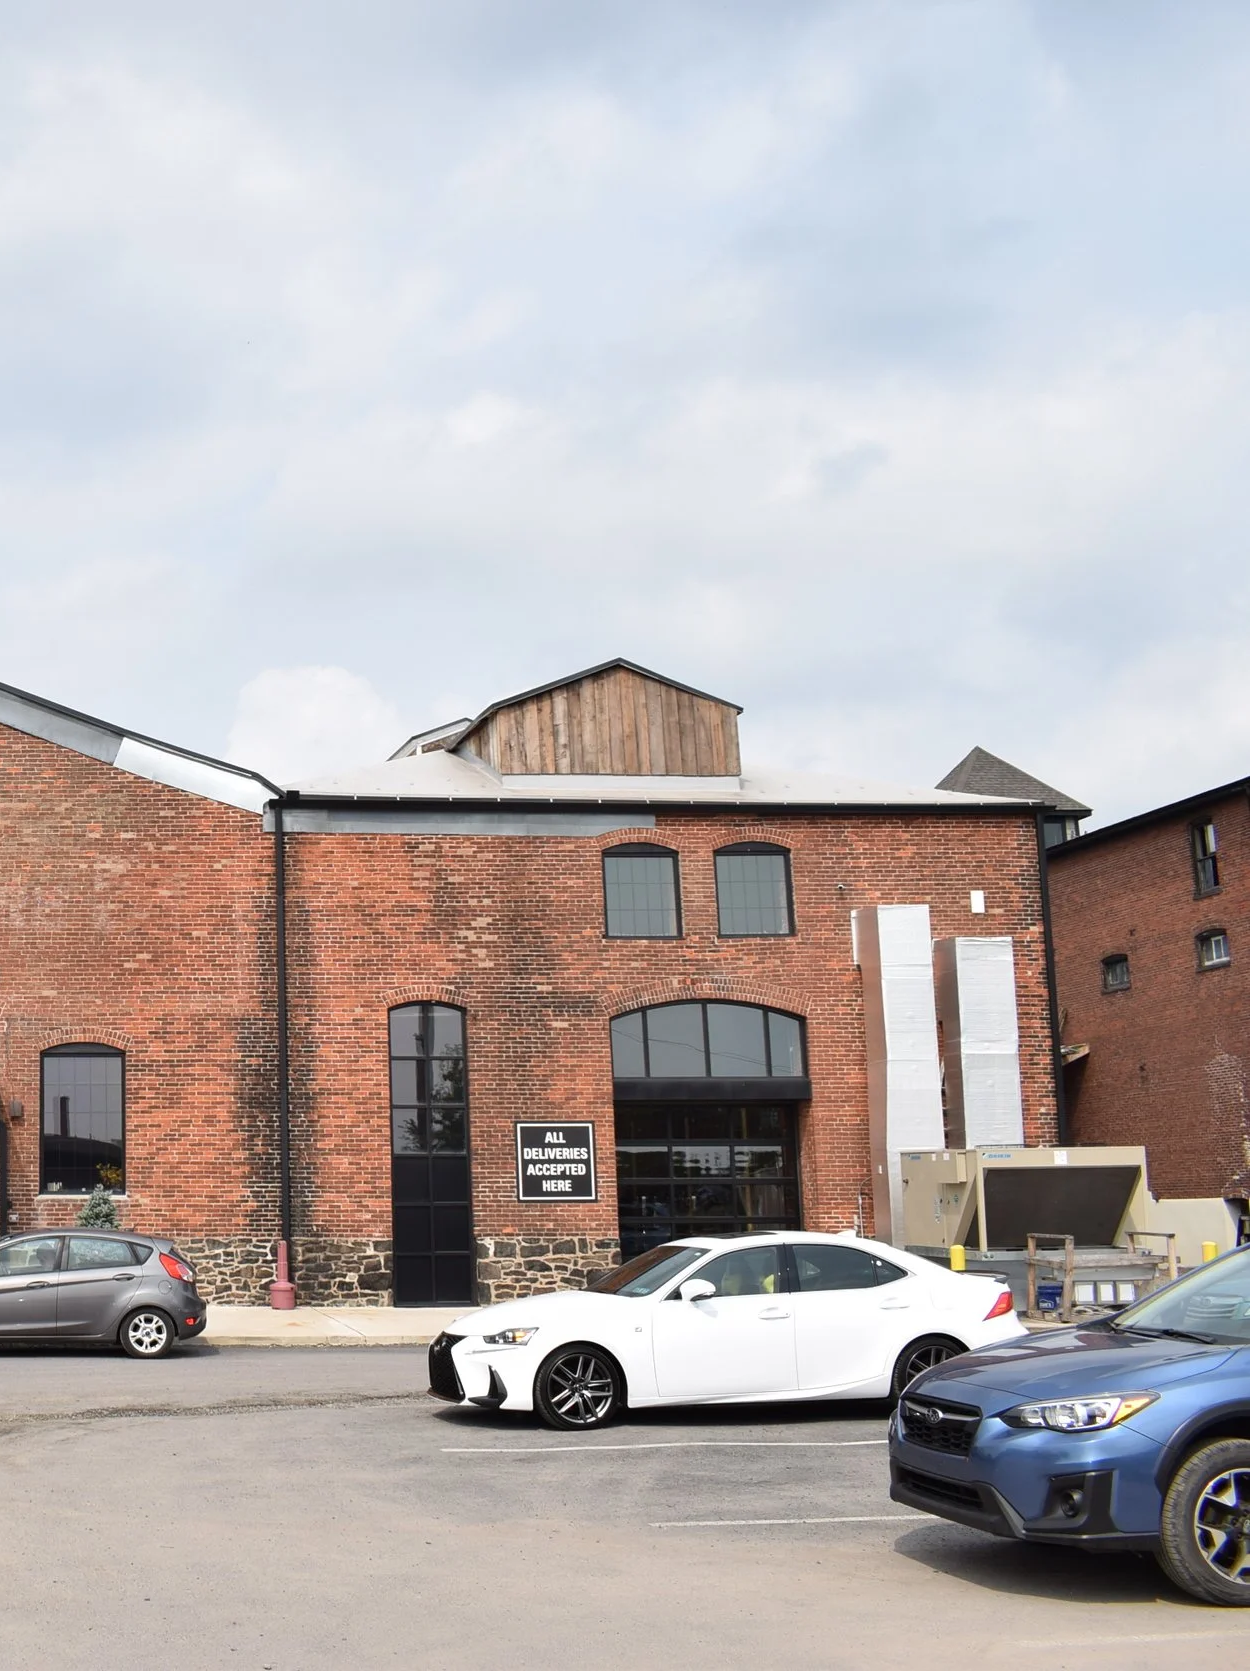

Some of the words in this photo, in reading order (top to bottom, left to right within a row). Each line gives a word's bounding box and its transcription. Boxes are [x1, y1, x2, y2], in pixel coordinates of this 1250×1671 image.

[545, 1131, 566, 1143] ALL
[523, 1147, 588, 1160] DELIVERIES
[526, 1163, 586, 1175] ACCEPTED
[542, 1179, 572, 1192] HERE
